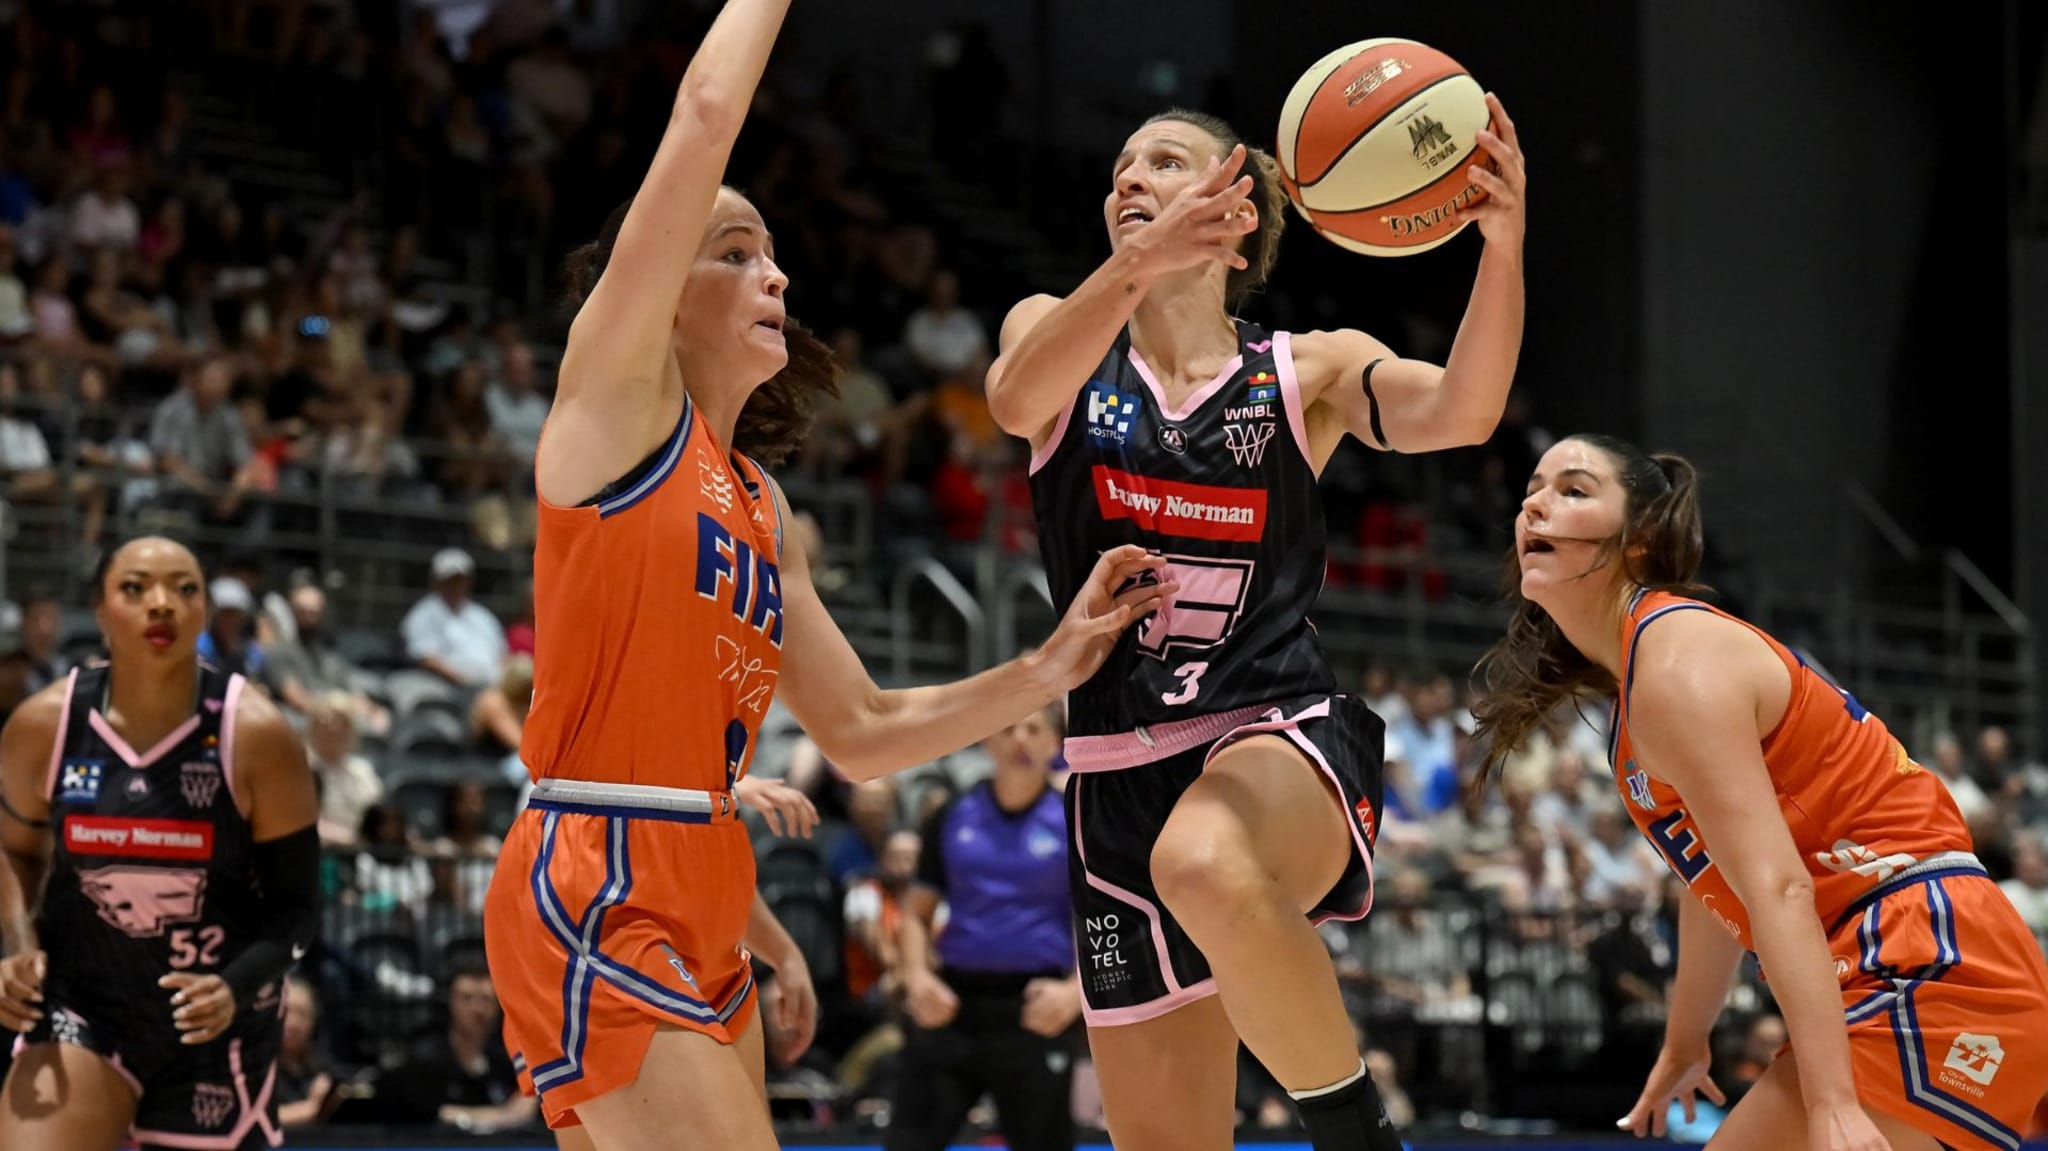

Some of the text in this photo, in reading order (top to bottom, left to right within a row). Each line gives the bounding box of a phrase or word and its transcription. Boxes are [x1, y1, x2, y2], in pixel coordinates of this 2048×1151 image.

[1388, 183, 1481, 238] ALDING
[1224, 404, 1276, 421] WNBL
[1164, 494, 1254, 525] Norman
[694, 511, 784, 651] FIR
[1161, 661, 1209, 706] 3
[70, 823, 204, 849] Harvey Norman
[168, 925, 226, 970] 52
[1938, 1071, 1985, 1099] Townsville
